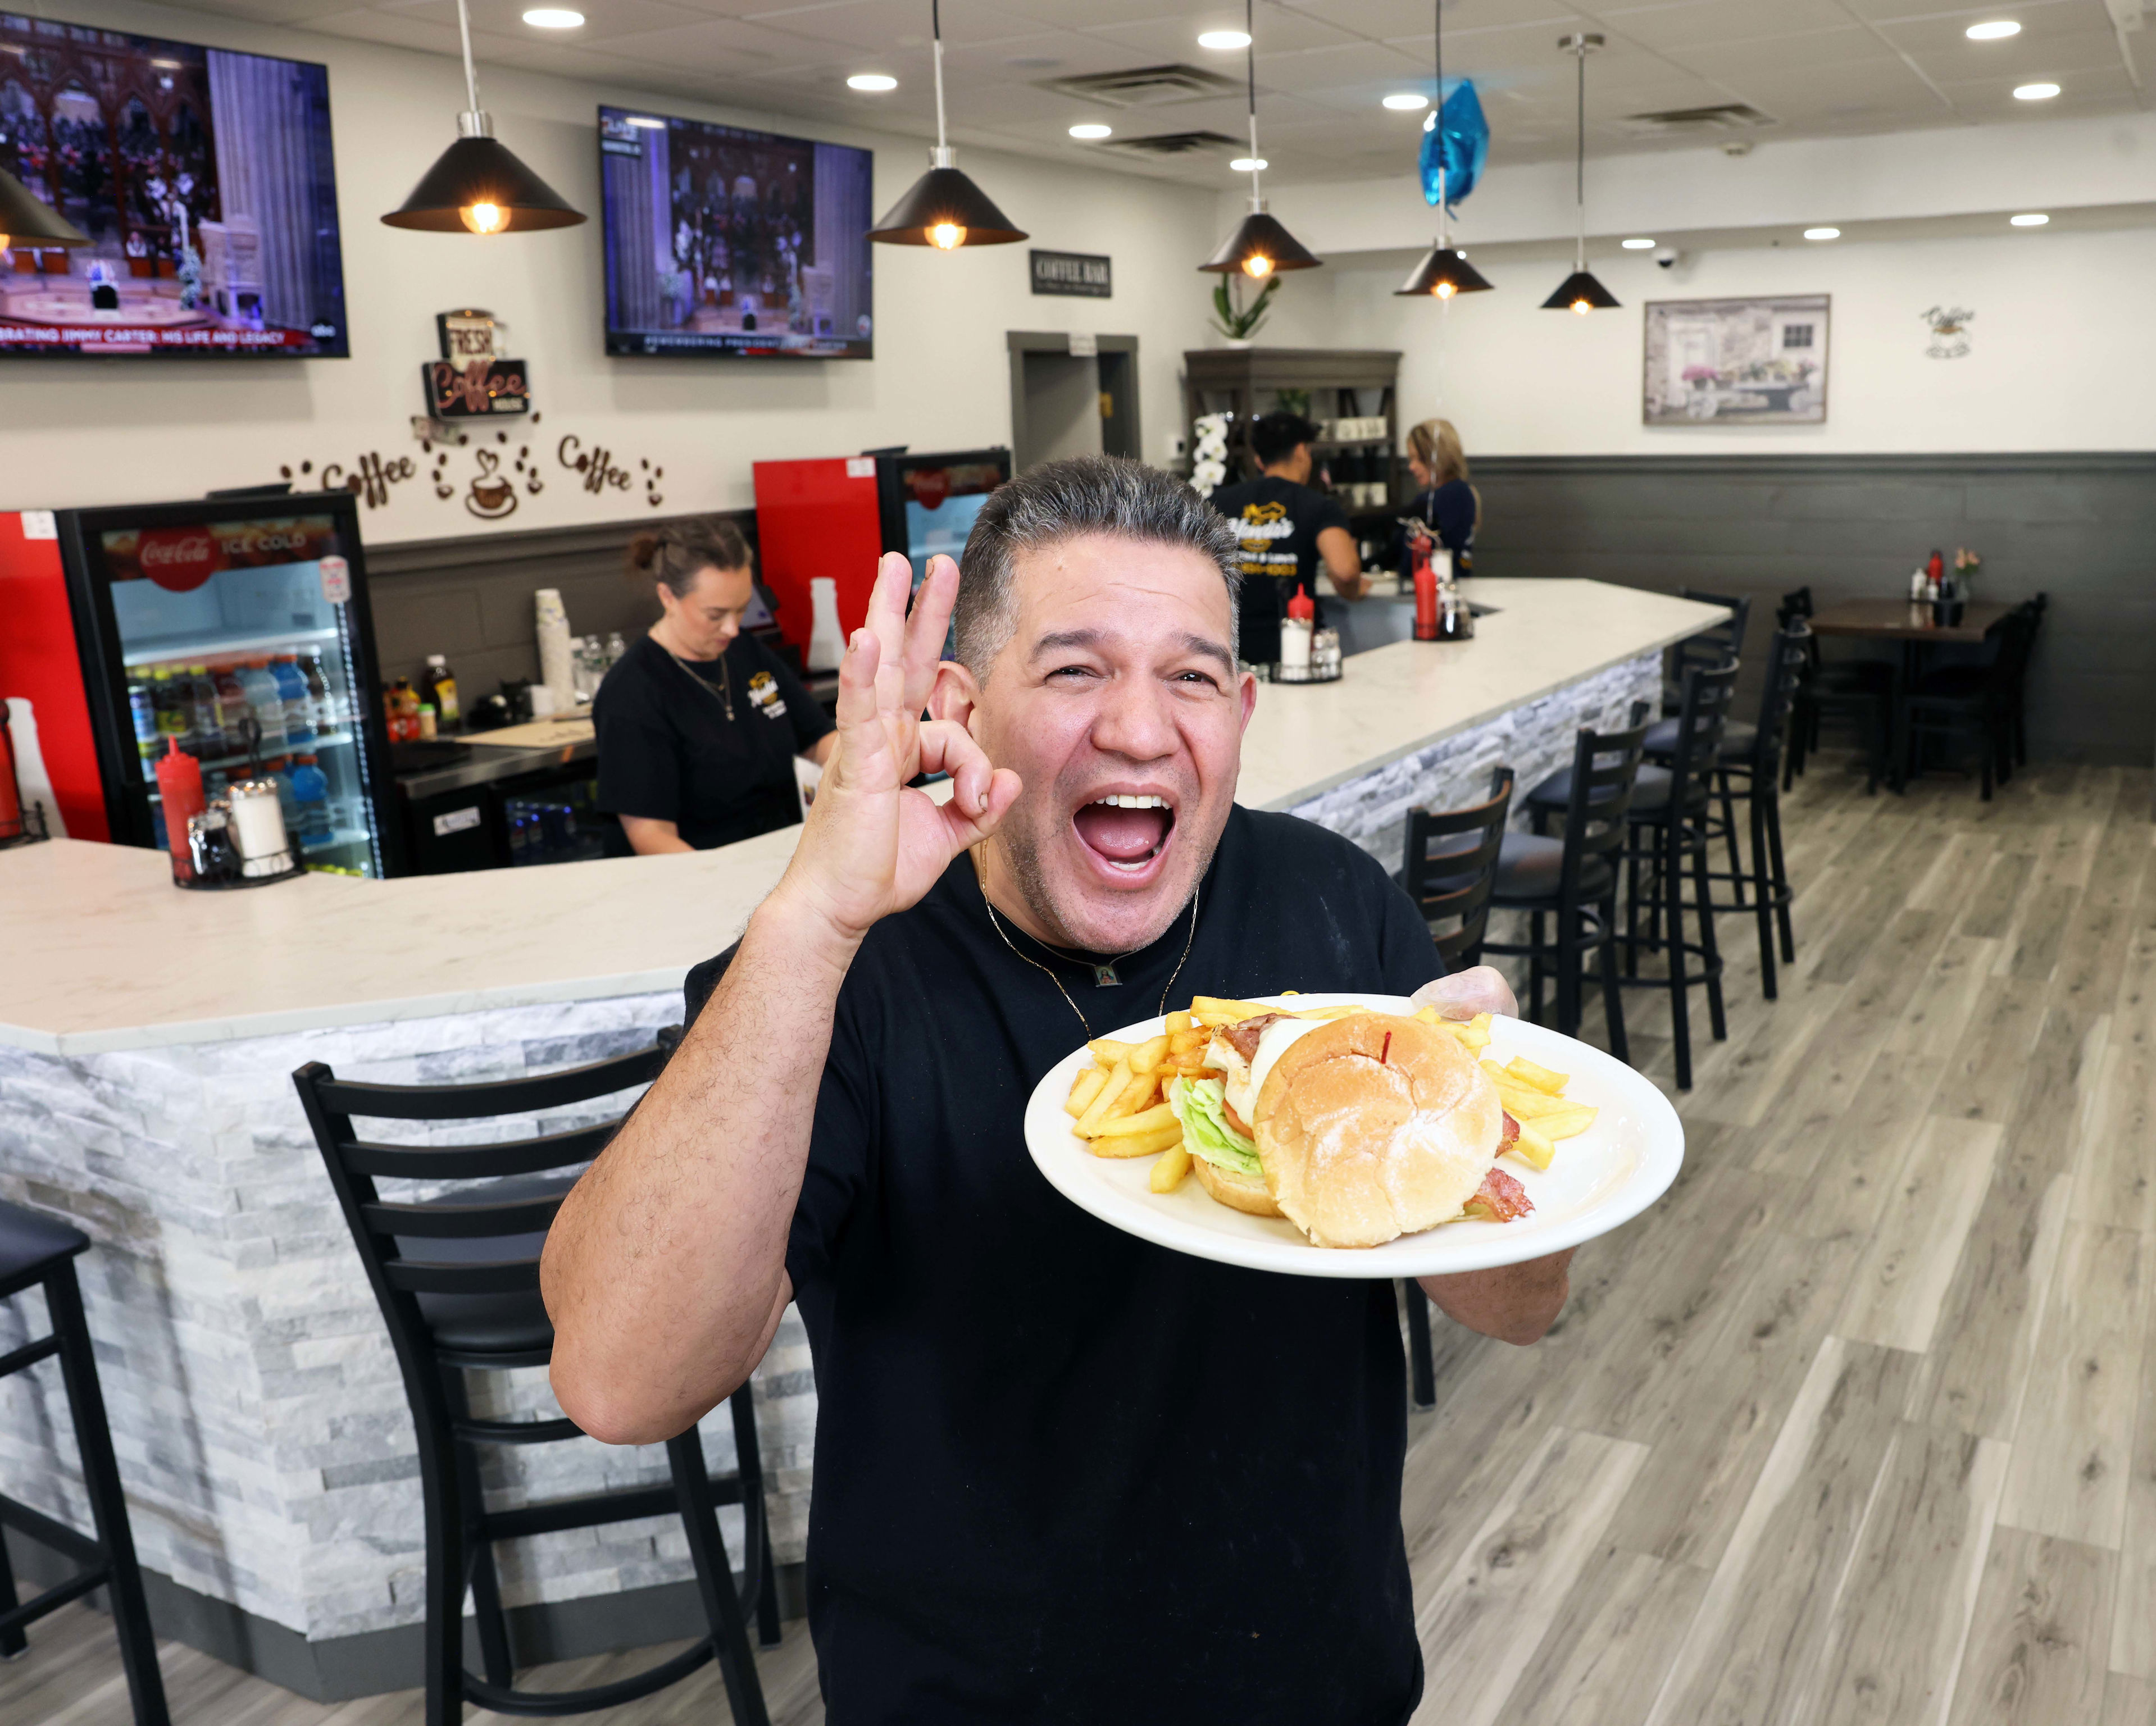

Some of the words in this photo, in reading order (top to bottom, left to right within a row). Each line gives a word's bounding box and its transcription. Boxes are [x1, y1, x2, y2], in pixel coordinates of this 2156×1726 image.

[1036, 258, 1081, 283] COFFEE
[1082, 261, 1108, 284] BAR
[61, 328, 103, 342] JIMMY
[184, 330, 211, 344] LIFE
[211, 330, 238, 344] AND
[239, 330, 286, 345] LEGACY
[450, 328, 493, 355] FRESH
[433, 359, 527, 413] Coffee
[557, 435, 633, 494] Coffee
[142, 537, 210, 566] Coca-Cola
[221, 535, 252, 555] ICE
[257, 531, 307, 551] COLD
